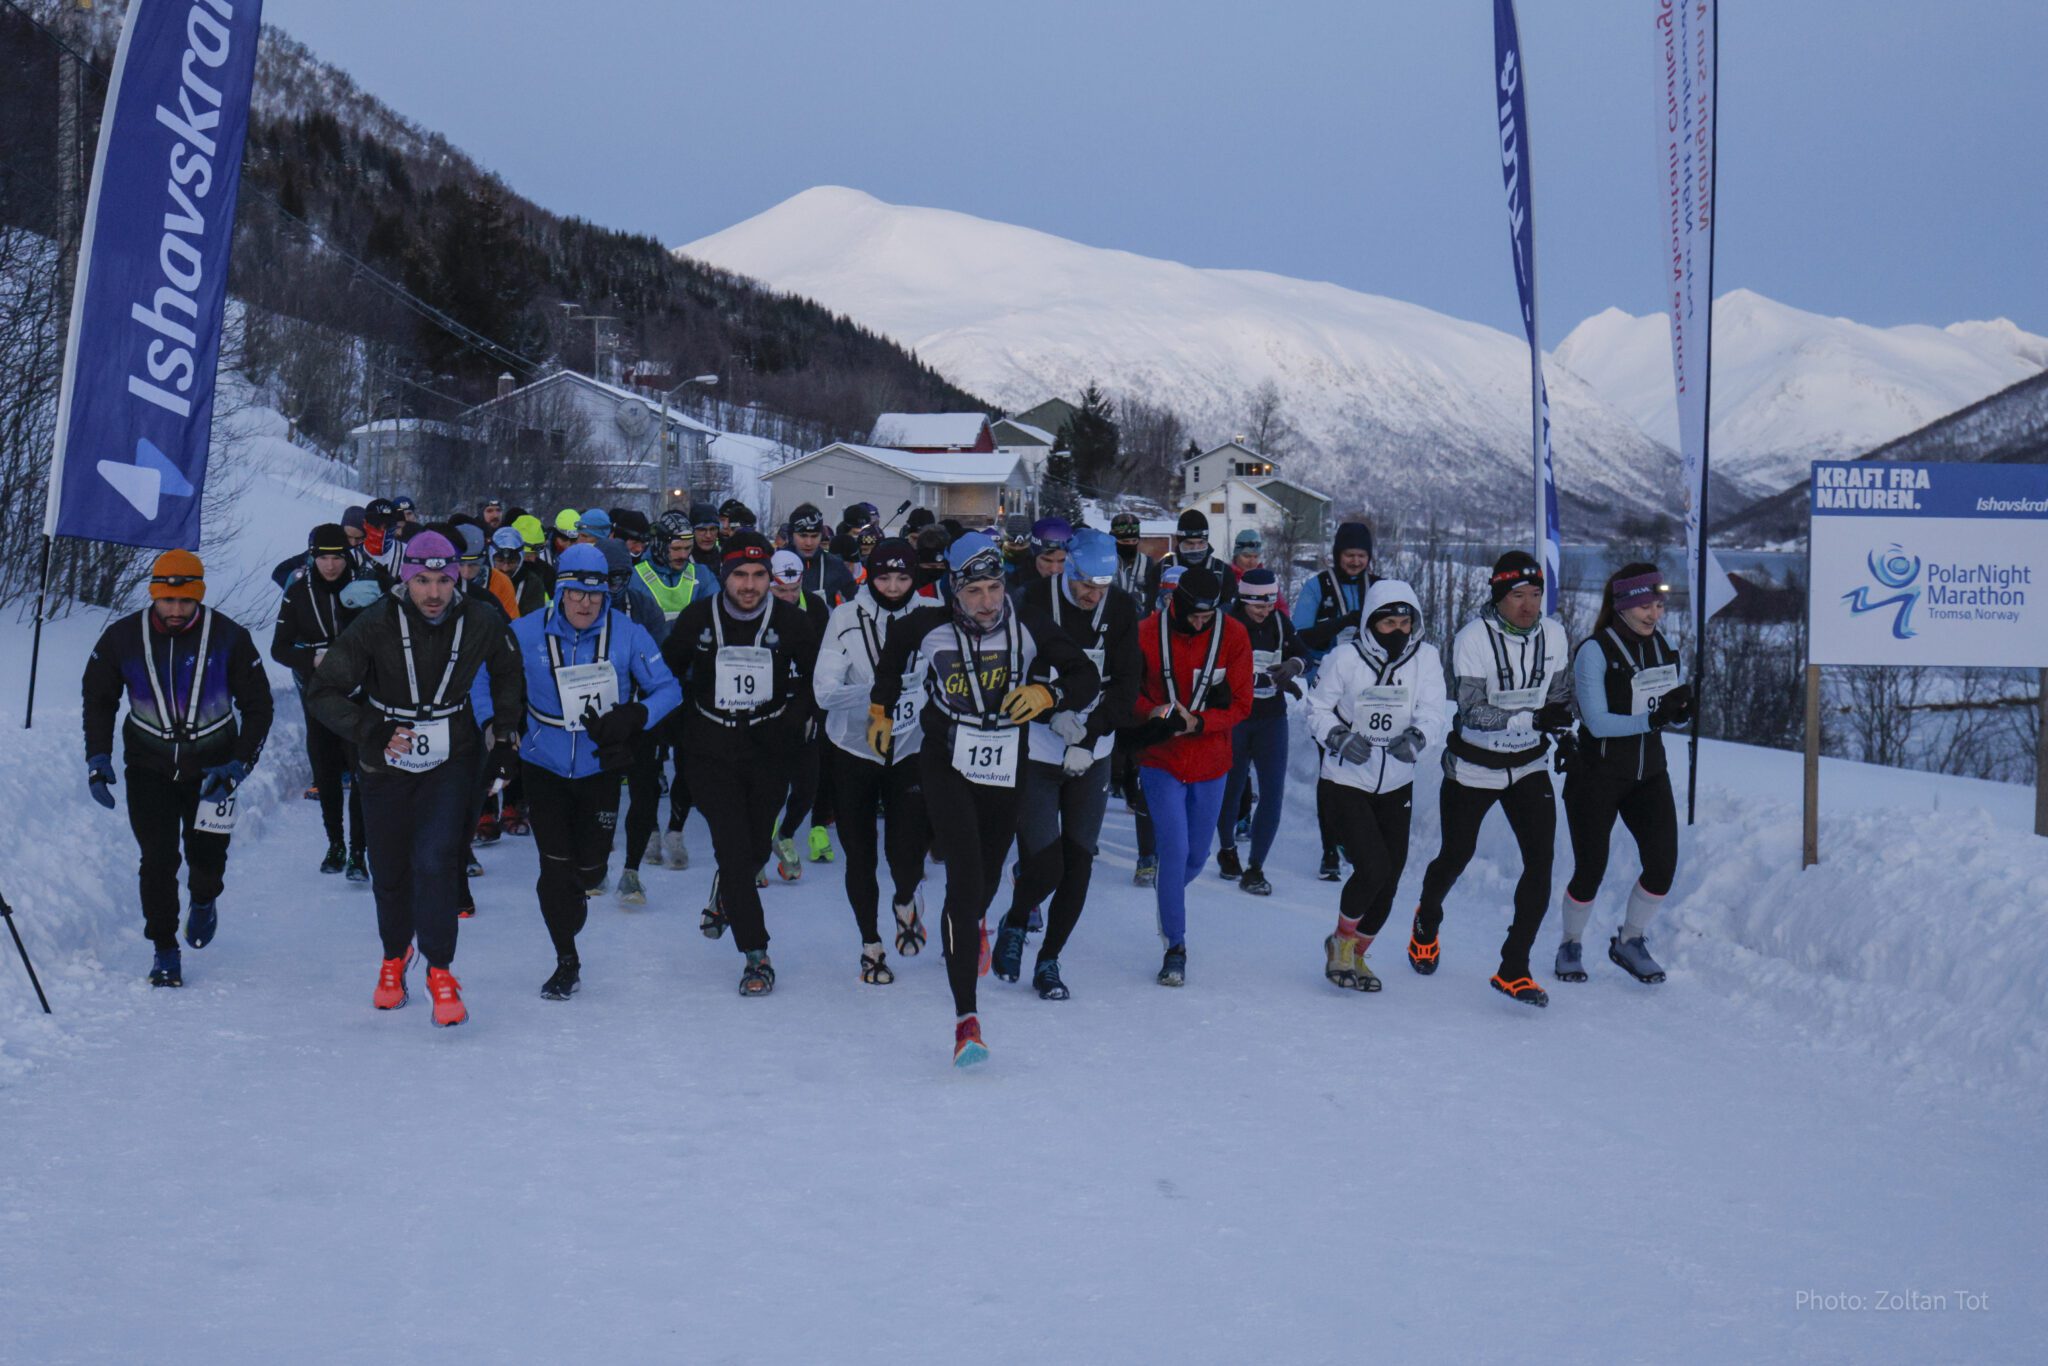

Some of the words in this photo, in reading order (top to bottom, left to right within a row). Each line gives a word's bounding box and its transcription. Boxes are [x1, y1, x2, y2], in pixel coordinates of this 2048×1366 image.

[1817, 468, 1884, 488] KRAFT
[1890, 469, 1930, 489] FRA
[1817, 489, 1921, 509] NATUREN.
[1928, 564, 2031, 589] PolarNight
[1928, 586, 2024, 606] Marathon
[1976, 608, 2019, 623] Norway
[733, 674, 755, 695] 19
[578, 692, 601, 714] 71
[1369, 712, 1392, 732] 86
[968, 745, 1004, 767] 131
[215, 798, 236, 818] 87
